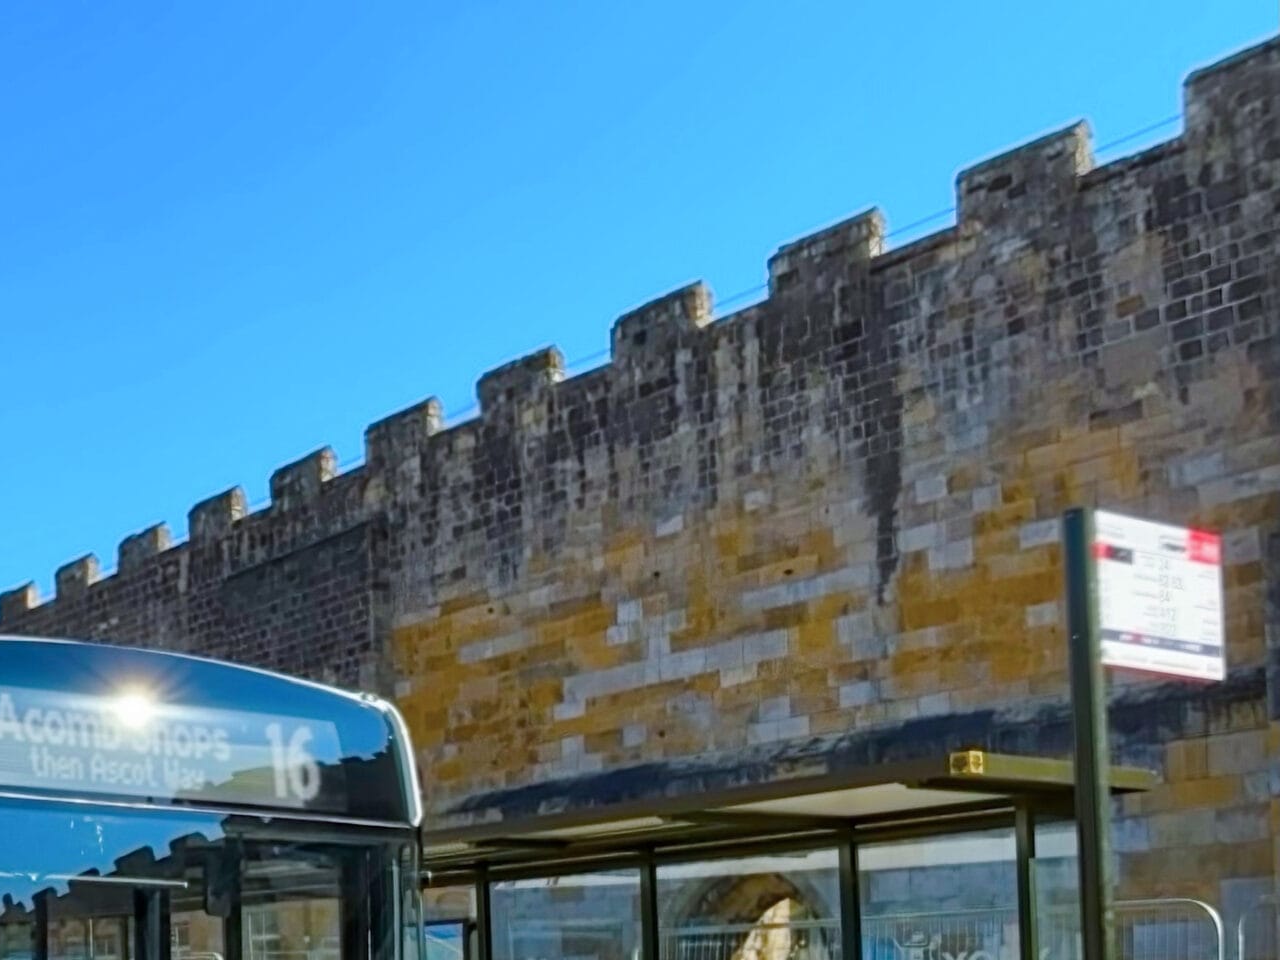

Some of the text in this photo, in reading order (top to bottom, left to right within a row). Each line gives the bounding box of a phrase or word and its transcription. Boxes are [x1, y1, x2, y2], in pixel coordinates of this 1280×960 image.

[30, 747, 205, 793] then Ascot Way
[263, 721, 322, 803] 16
